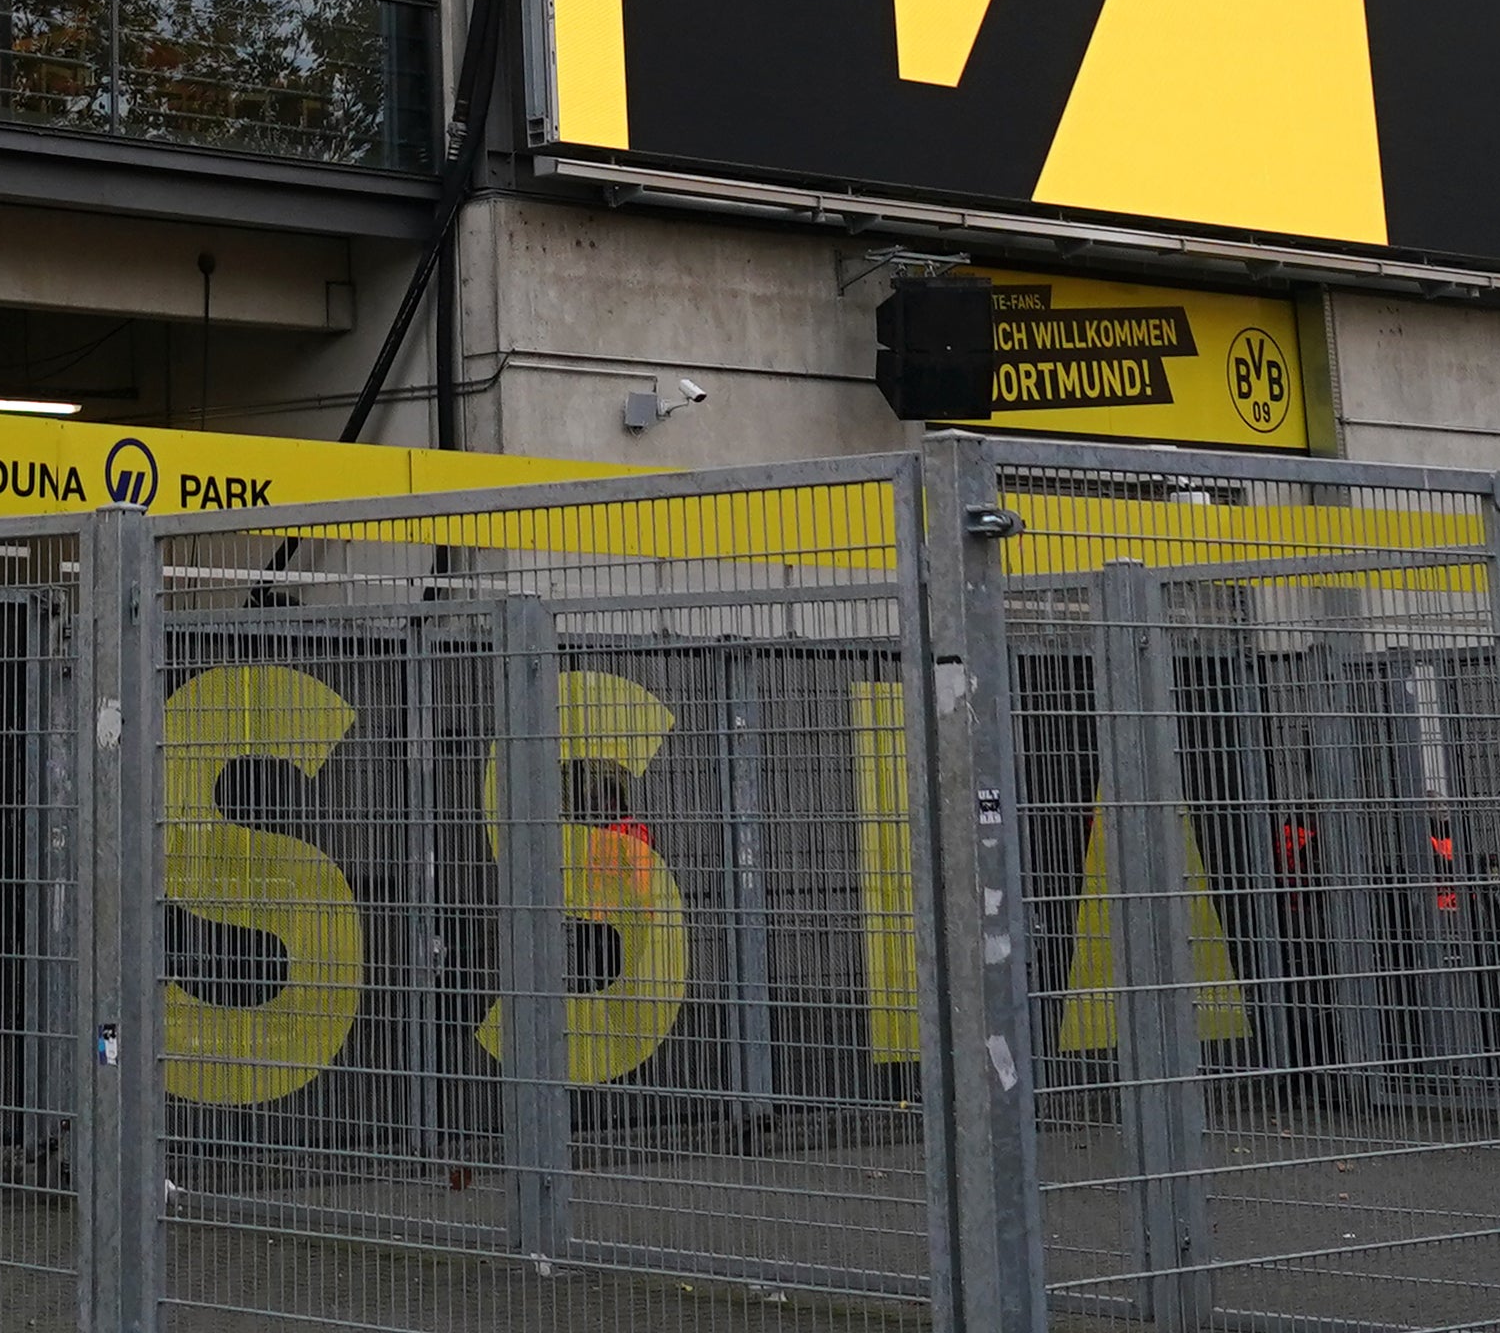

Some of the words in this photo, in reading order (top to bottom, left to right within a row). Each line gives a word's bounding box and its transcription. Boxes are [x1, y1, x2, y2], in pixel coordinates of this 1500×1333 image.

[1030, 318, 1178, 350] WILLKOMMEN
[1234, 337, 1285, 403] BVB
[1252, 400, 1271, 423] 09
[179, 473, 273, 509] PARK
